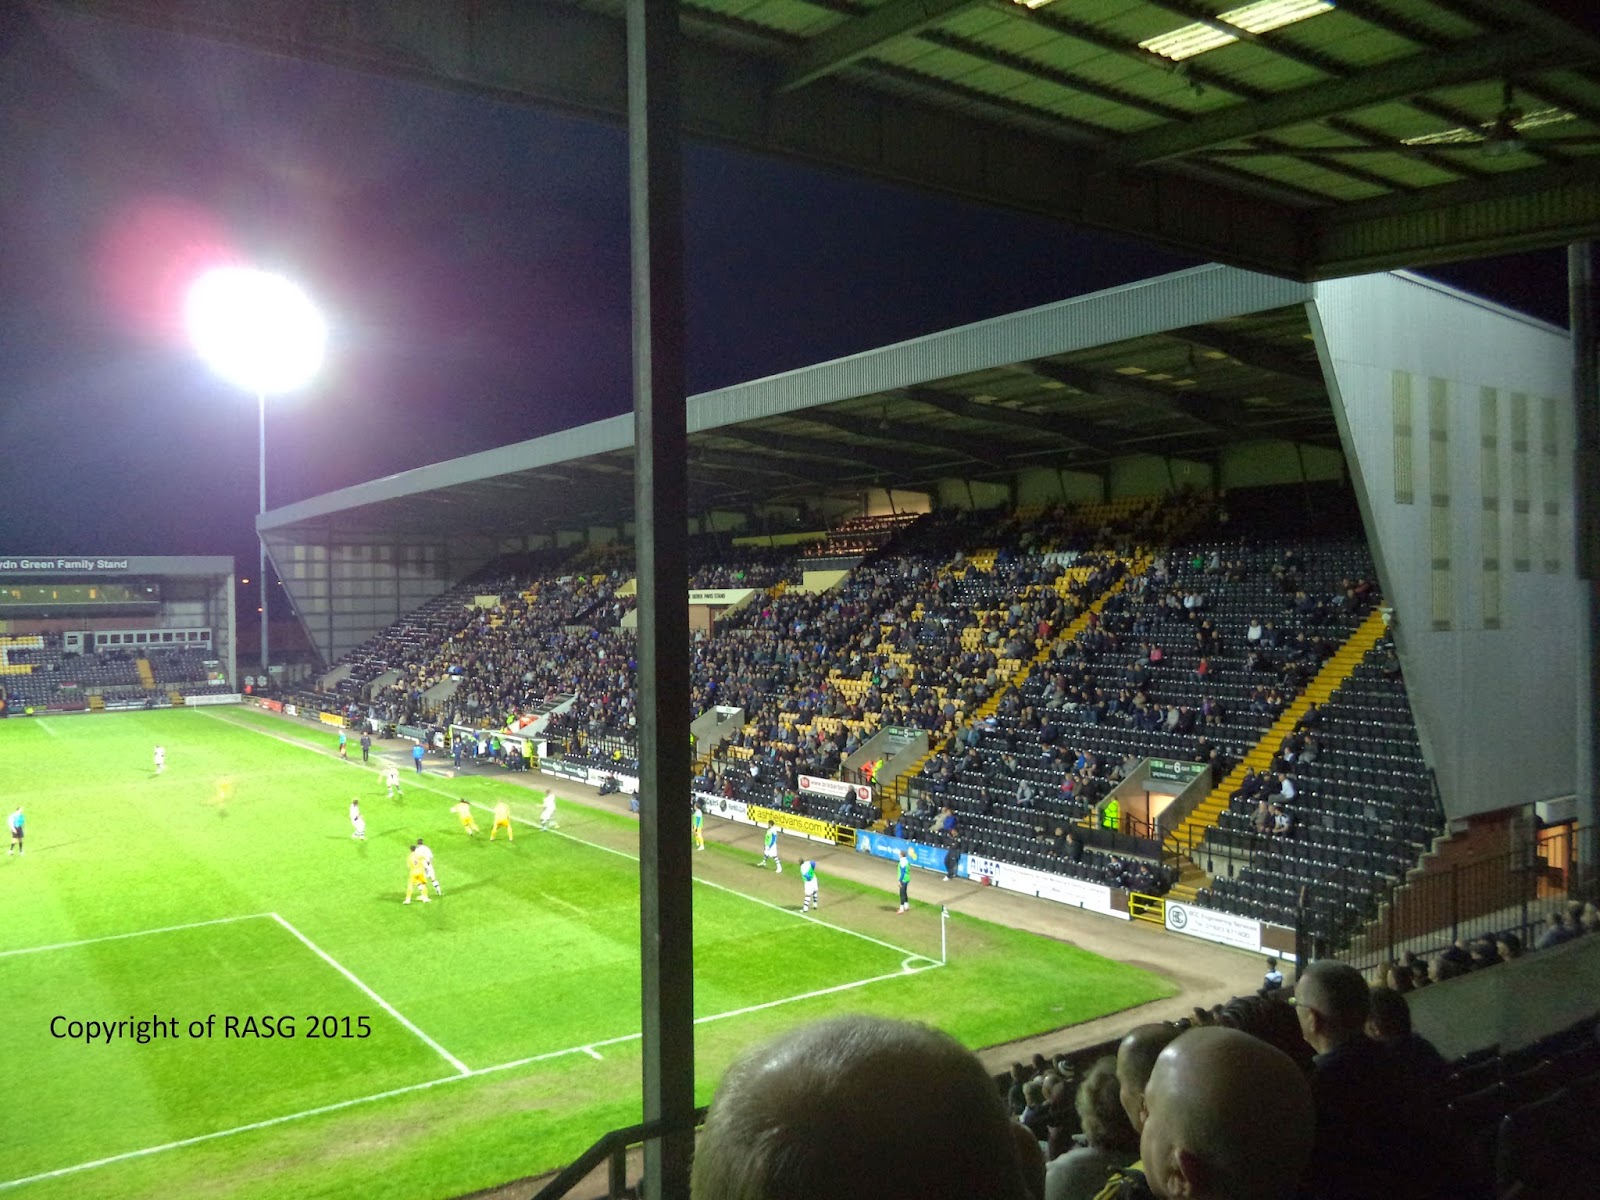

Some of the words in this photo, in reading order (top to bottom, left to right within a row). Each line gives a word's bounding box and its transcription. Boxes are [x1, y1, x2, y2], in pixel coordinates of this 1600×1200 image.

[21, 560, 54, 569] Green
[57, 560, 94, 571] Family
[97, 560, 127, 568] Stand
[1173, 761, 1181, 773] 6
[757, 810, 822, 832] ashfieldvans.com
